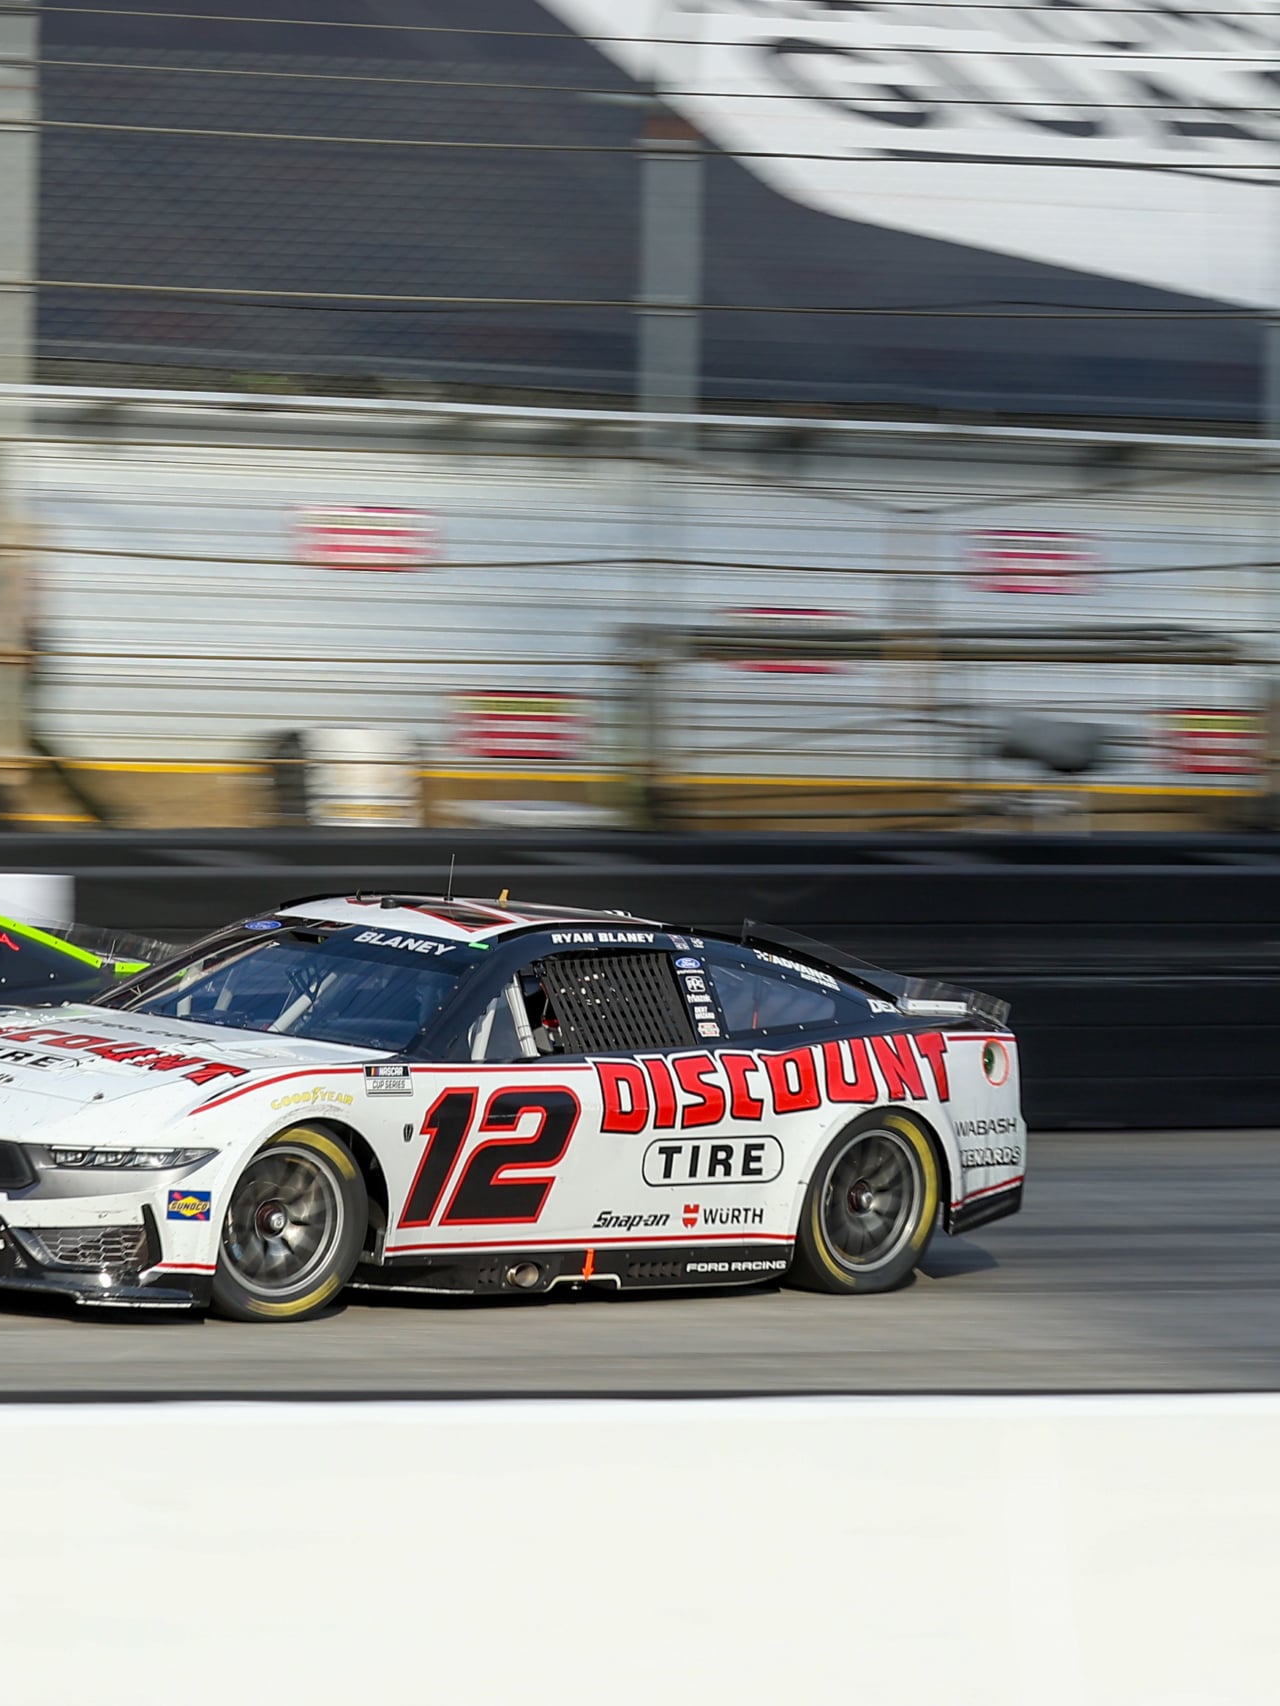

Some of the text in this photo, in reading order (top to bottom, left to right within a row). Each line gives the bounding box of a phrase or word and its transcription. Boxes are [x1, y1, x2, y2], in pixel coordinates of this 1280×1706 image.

[353, 930, 457, 957] BLANEY
[551, 932, 655, 945] RYAN BLANEY
[771, 954, 839, 986] ADVANCE
[378, 1066, 405, 1077] NASCAR
[372, 1079, 406, 1090] CUP SERIES
[590, 1031, 951, 1135] DISCOUNT
[271, 1087, 354, 1111] GOODYEAR
[954, 1117, 1018, 1138] WABASH
[397, 1085, 582, 1229] 12
[657, 1143, 766, 1180] TIRE
[169, 1200, 210, 1212] SUNOCO
[592, 1210, 671, 1232] Snap-on
[686, 1260, 787, 1274] FORD RACING
